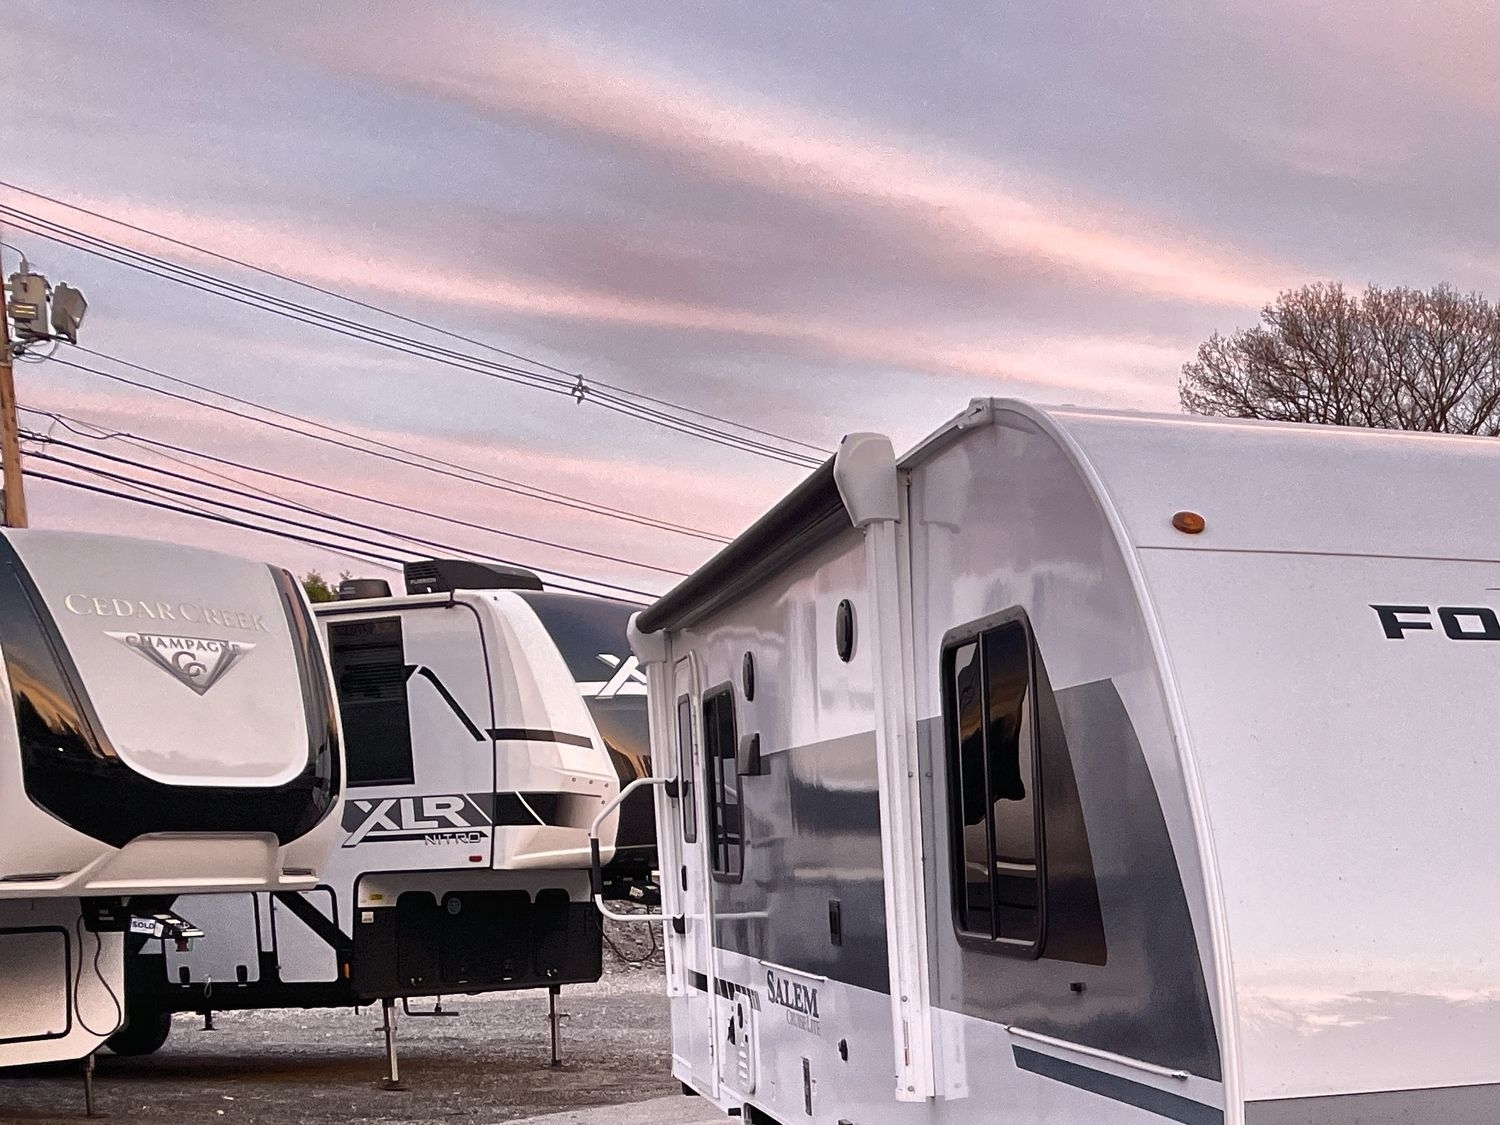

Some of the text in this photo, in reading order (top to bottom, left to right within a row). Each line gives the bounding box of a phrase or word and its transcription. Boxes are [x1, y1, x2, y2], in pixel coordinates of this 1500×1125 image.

[64, 593, 270, 633] CEDAR CREEK
[125, 635, 242, 654] CHAMPAGNE
[341, 797, 471, 848] XLR
[424, 832, 482, 846] NITRO
[132, 921, 155, 929] SOLD
[766, 969, 820, 1019] SALEM
